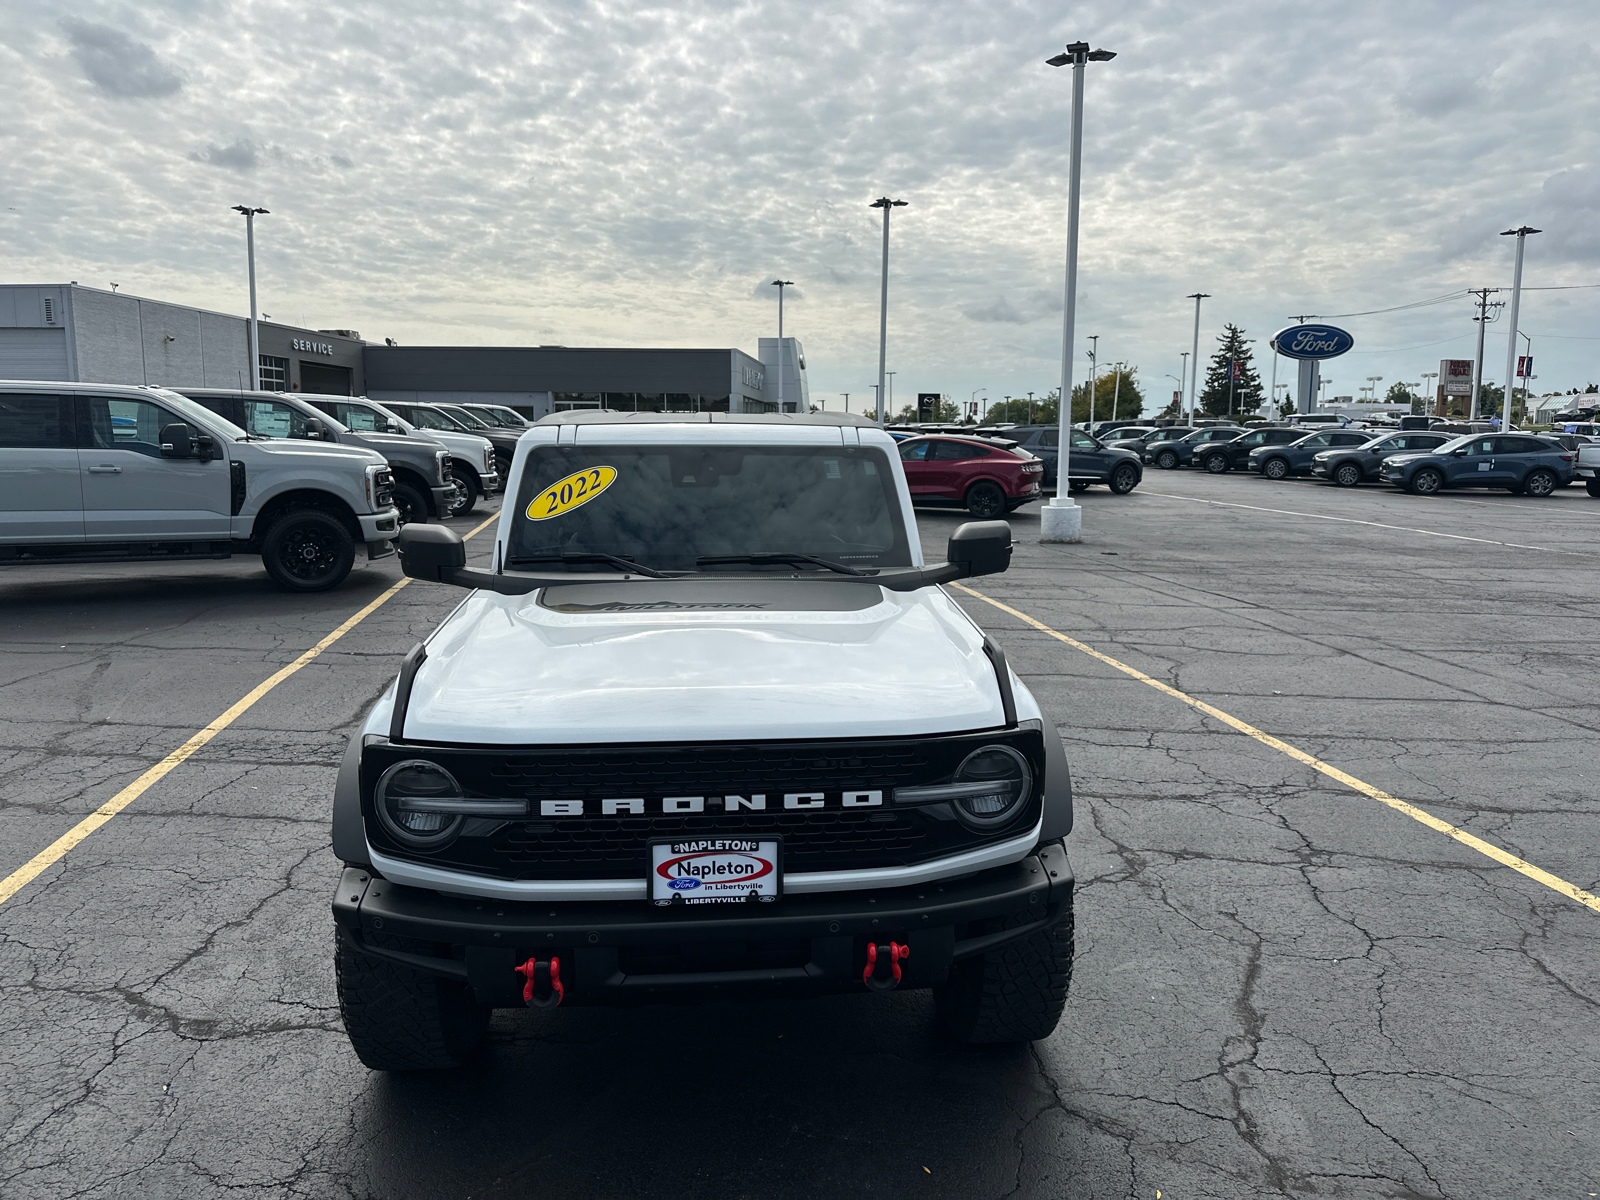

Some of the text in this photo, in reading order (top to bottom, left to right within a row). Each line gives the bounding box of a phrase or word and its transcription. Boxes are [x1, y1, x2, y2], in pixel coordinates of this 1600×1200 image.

[293, 338, 333, 355] SERVICE
[1291, 330, 1339, 351] Ford
[545, 469, 602, 515] 2022
[540, 790, 883, 816] BRONCO
[679, 840, 751, 853] NAPLETON
[677, 860, 754, 879] Napleton
[674, 879, 696, 889] Ford
[715, 882, 763, 891] Libertyville
[685, 896, 747, 904] LIBERTYVILLE
